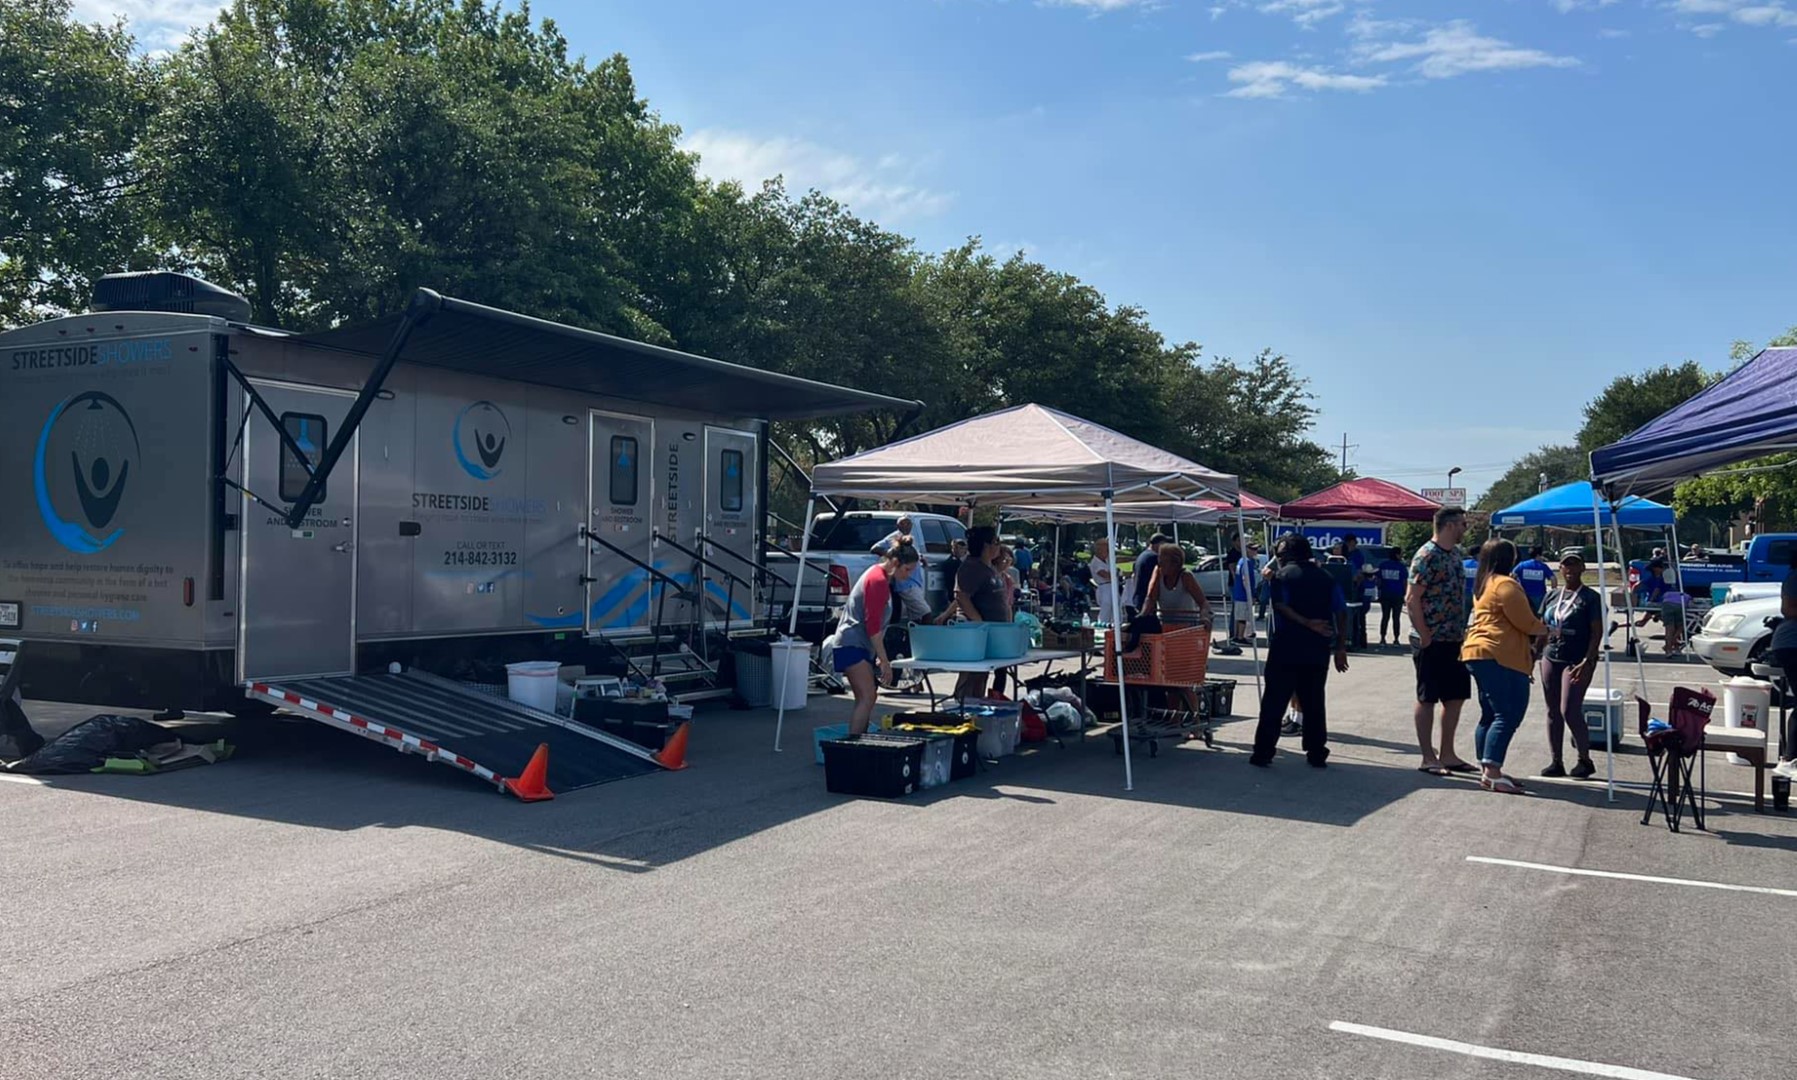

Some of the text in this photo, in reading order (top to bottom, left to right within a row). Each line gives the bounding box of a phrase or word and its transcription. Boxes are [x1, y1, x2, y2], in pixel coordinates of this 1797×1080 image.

[667, 443, 680, 543] STREETSIDE
[456, 541, 505, 550] CALL OR TEXT
[444, 551, 517, 565] 214-842-3132
[136, 563, 163, 575] dignity
